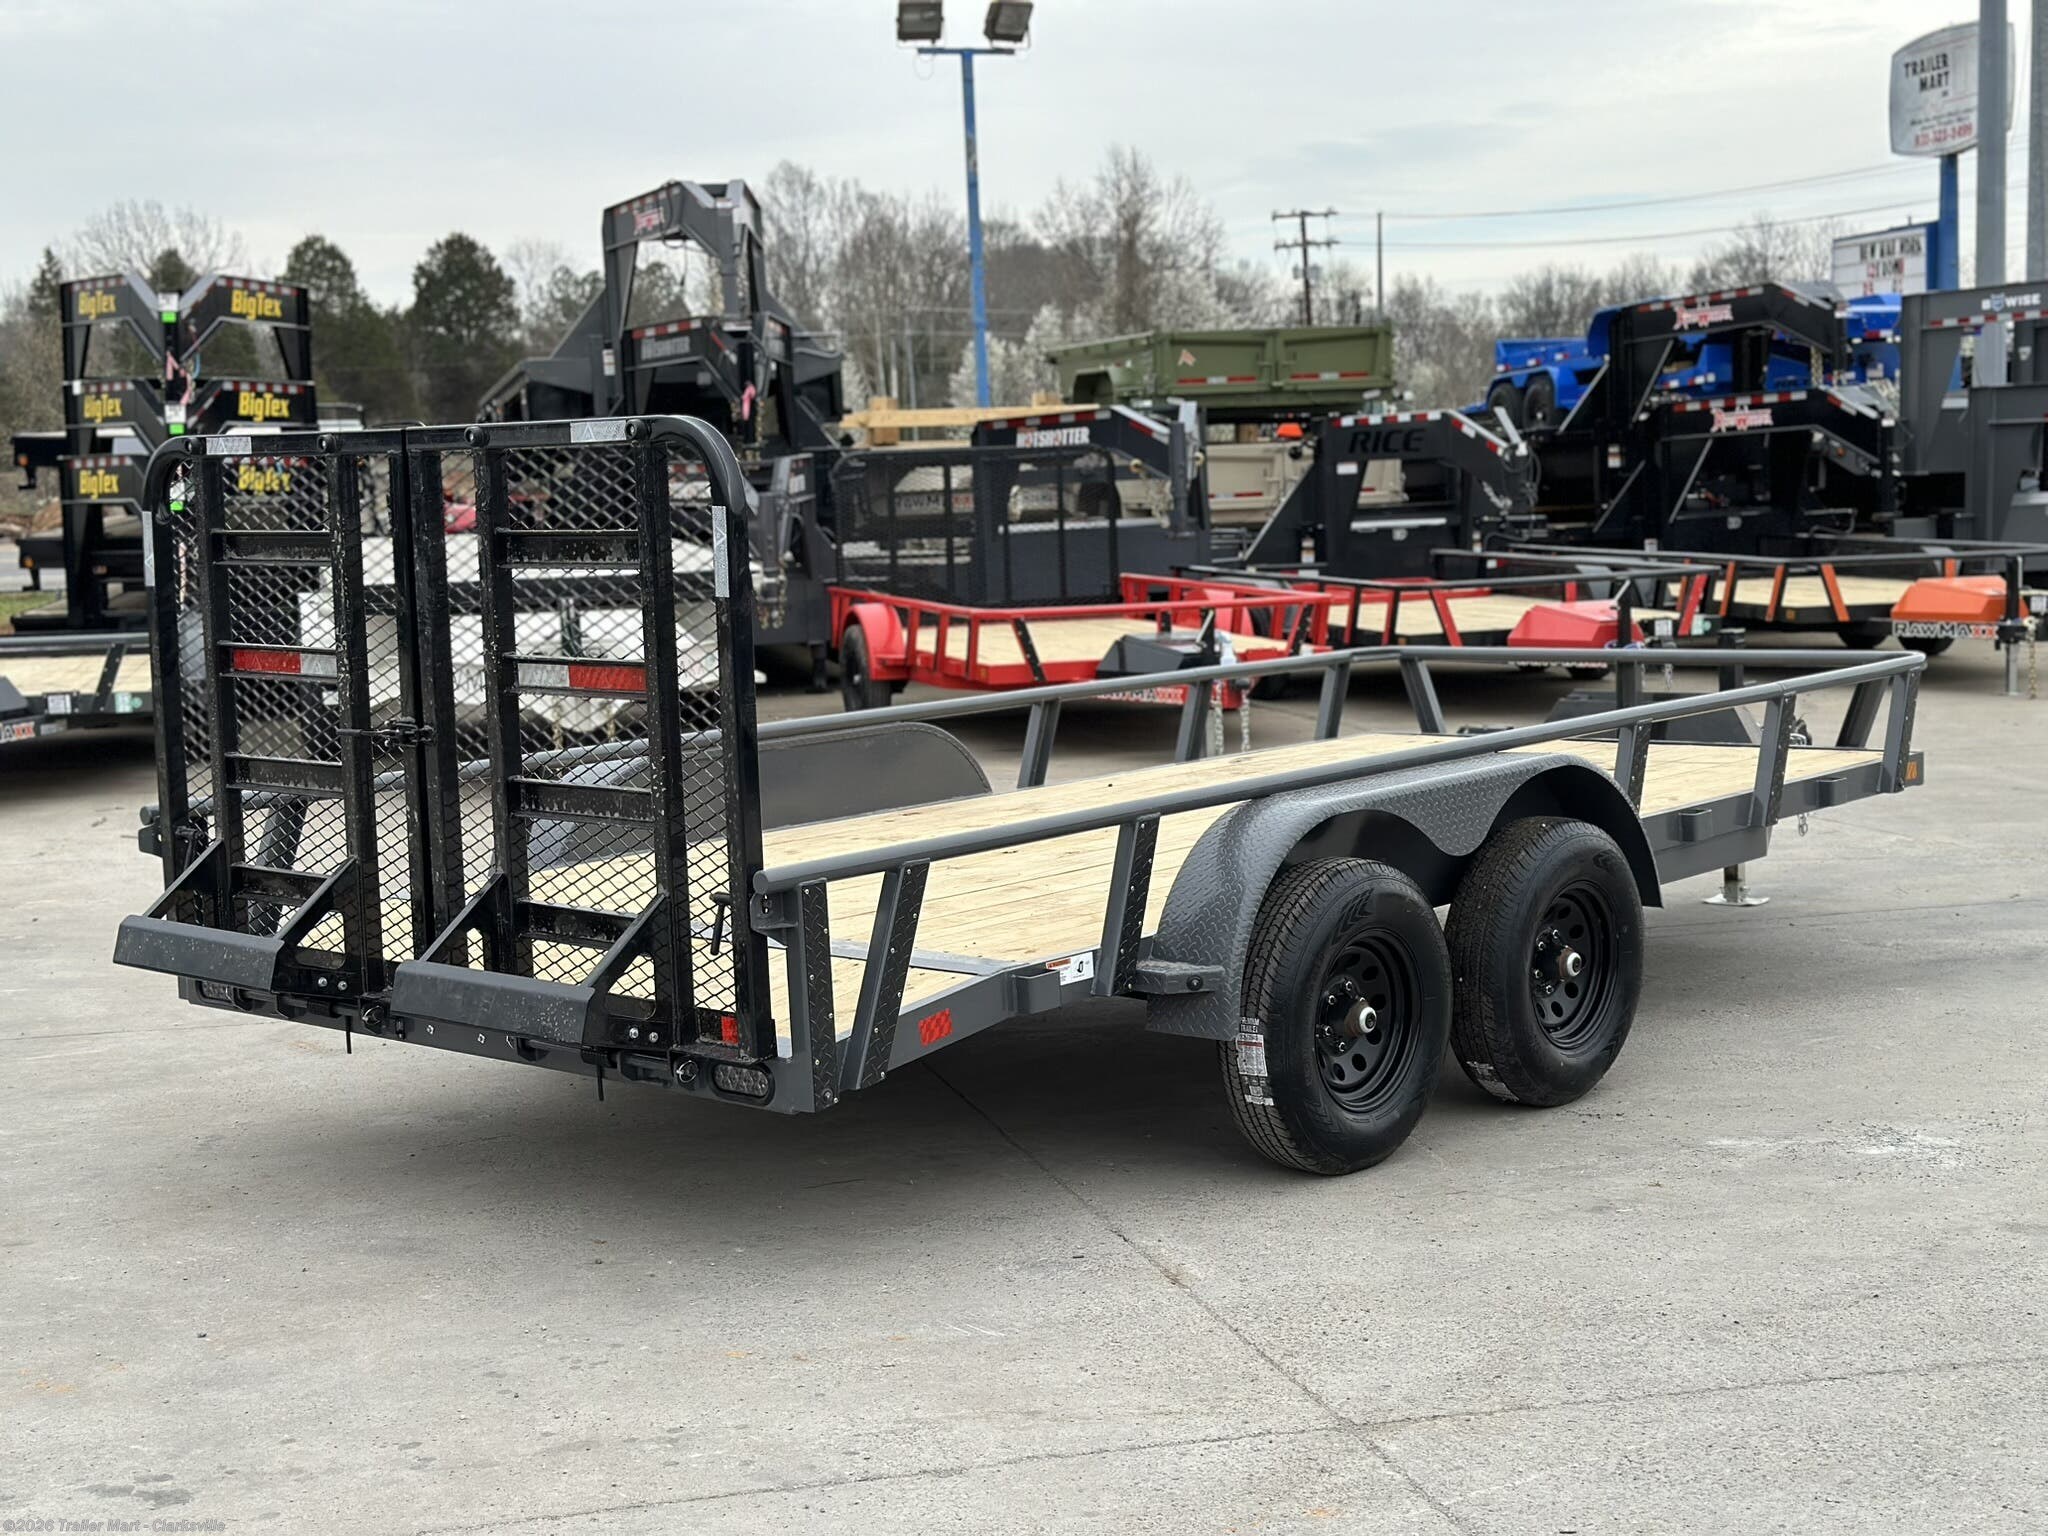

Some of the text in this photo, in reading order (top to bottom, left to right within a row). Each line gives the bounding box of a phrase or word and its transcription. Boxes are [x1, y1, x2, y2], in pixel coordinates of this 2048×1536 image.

[1904, 53, 1949, 78] TRAILER
[1920, 71, 1950, 92] MART
[78, 288, 116, 320] BigTex
[231, 289, 283, 321] BigTex
[84, 393, 122, 423] BigTex
[238, 391, 290, 422] BigTex
[1015, 426, 1091, 449] HOTSHOTTER
[1348, 428, 1427, 454] RICE
[79, 468, 119, 500] BigTex
